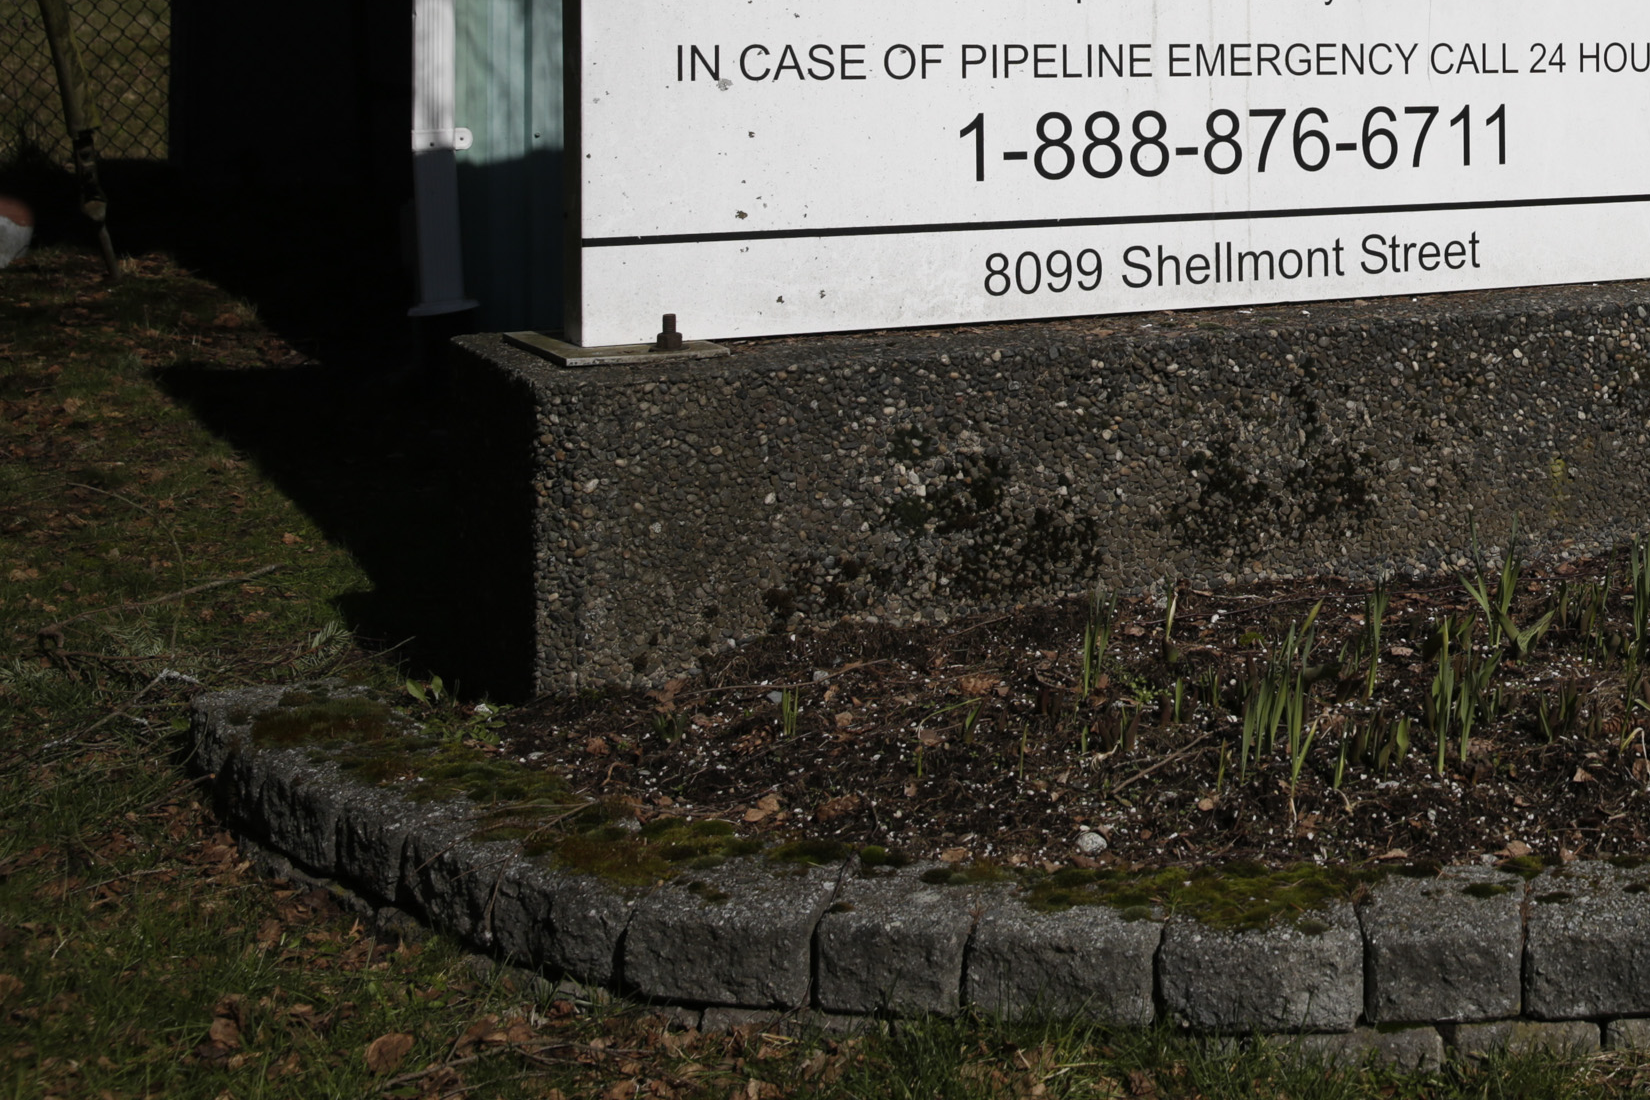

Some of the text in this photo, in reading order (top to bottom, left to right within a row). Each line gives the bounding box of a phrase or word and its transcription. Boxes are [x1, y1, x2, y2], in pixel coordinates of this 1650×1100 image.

[678, 45, 719, 81] IN
[740, 45, 866, 81] CASE
[884, 44, 943, 79] OF
[962, 44, 1152, 78] PIPELINE
[1169, 44, 1417, 76] EMERGENCY
[1431, 43, 1518, 74] CALL
[1530, 43, 1565, 73] 24
[960, 104, 1505, 181] 1-888-876-6711
[985, 232, 1480, 296] 8099 Shellmont Street
